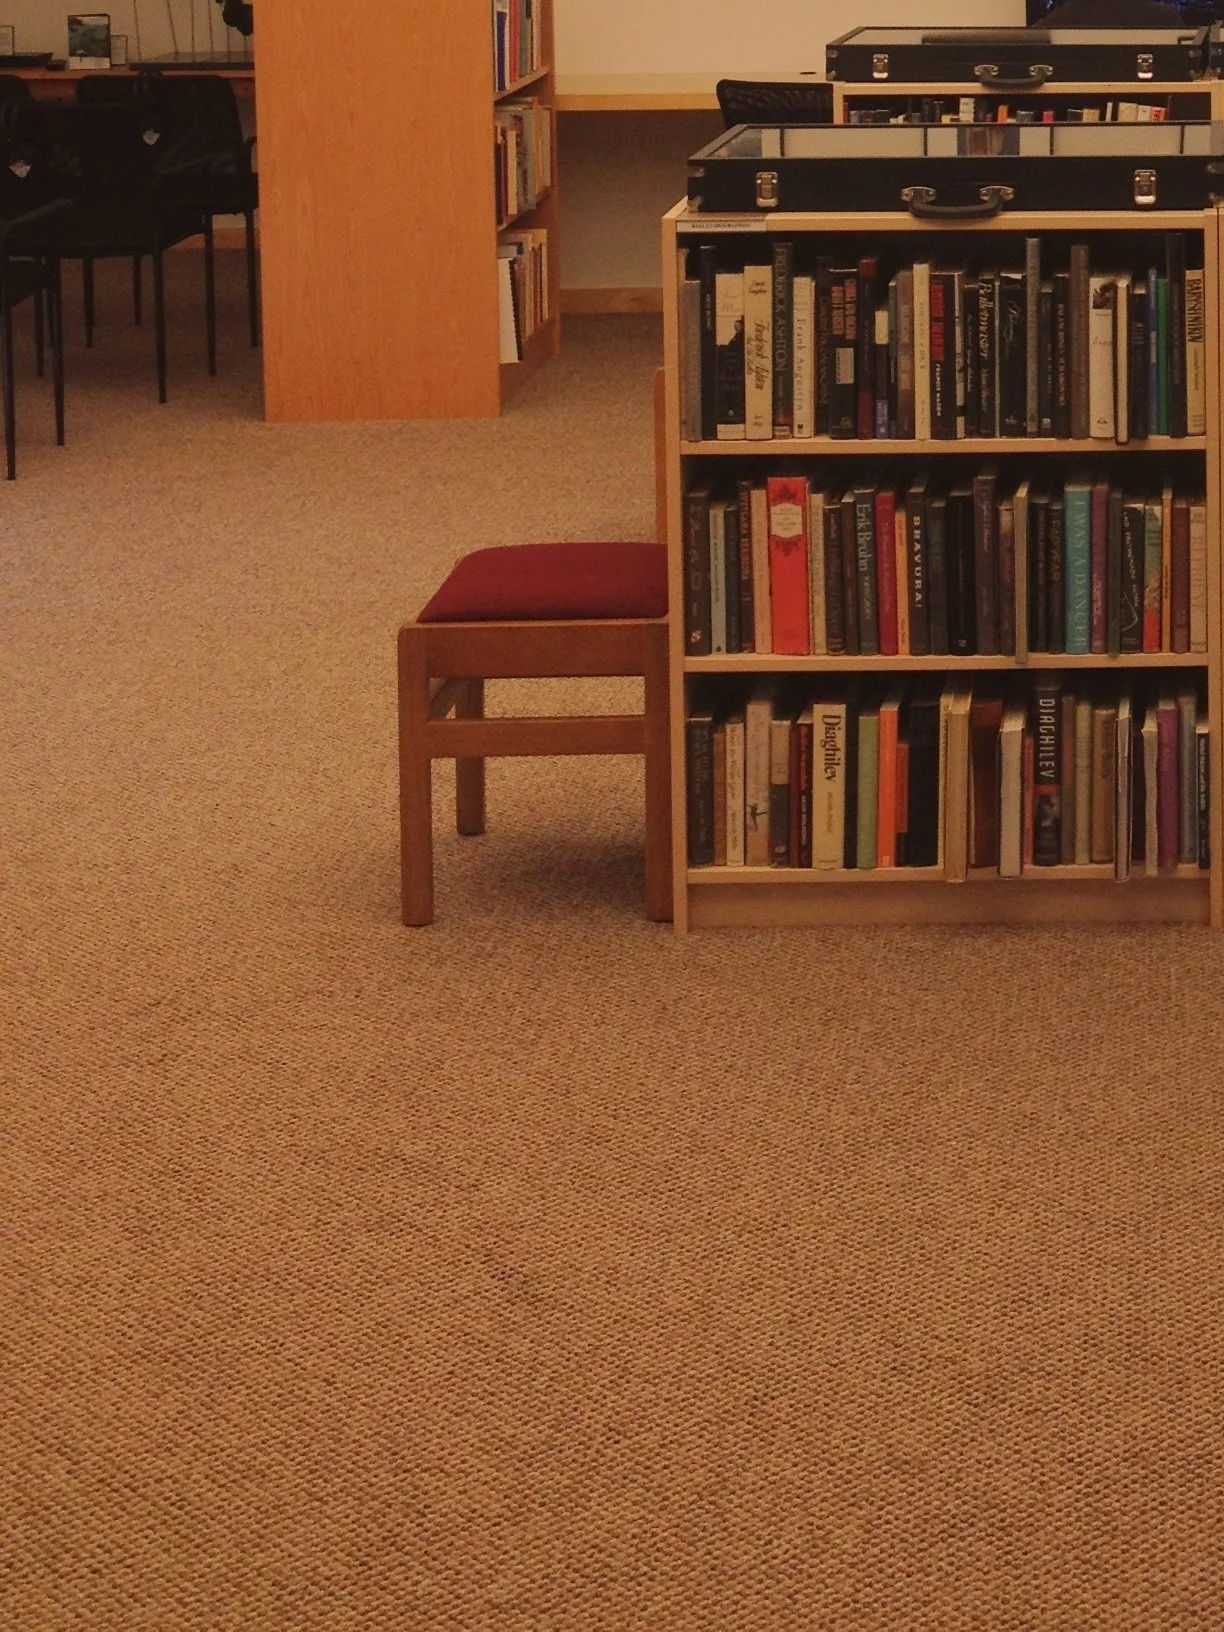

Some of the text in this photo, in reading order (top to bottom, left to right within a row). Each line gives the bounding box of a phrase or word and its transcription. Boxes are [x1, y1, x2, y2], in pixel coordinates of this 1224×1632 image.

[775, 247, 788, 371] FREDERICK ASHTON
[797, 319, 807, 351] Frank
[978, 282, 994, 360] Balletmaster
[1187, 278, 1203, 343] BARYSHNIKOV
[856, 503, 871, 529] Erik
[1075, 513, 1086, 548] WAS
[857, 532, 872, 571] Bruhn
[913, 515, 922, 608] BRAVURA!
[1051, 549, 1061, 582] YEAR
[1075, 556, 1085, 566] A
[1074, 573, 1087, 647] DANCER
[820, 714, 842, 781] Diaghilev
[1039, 698, 1056, 778] DIAGHILEV
